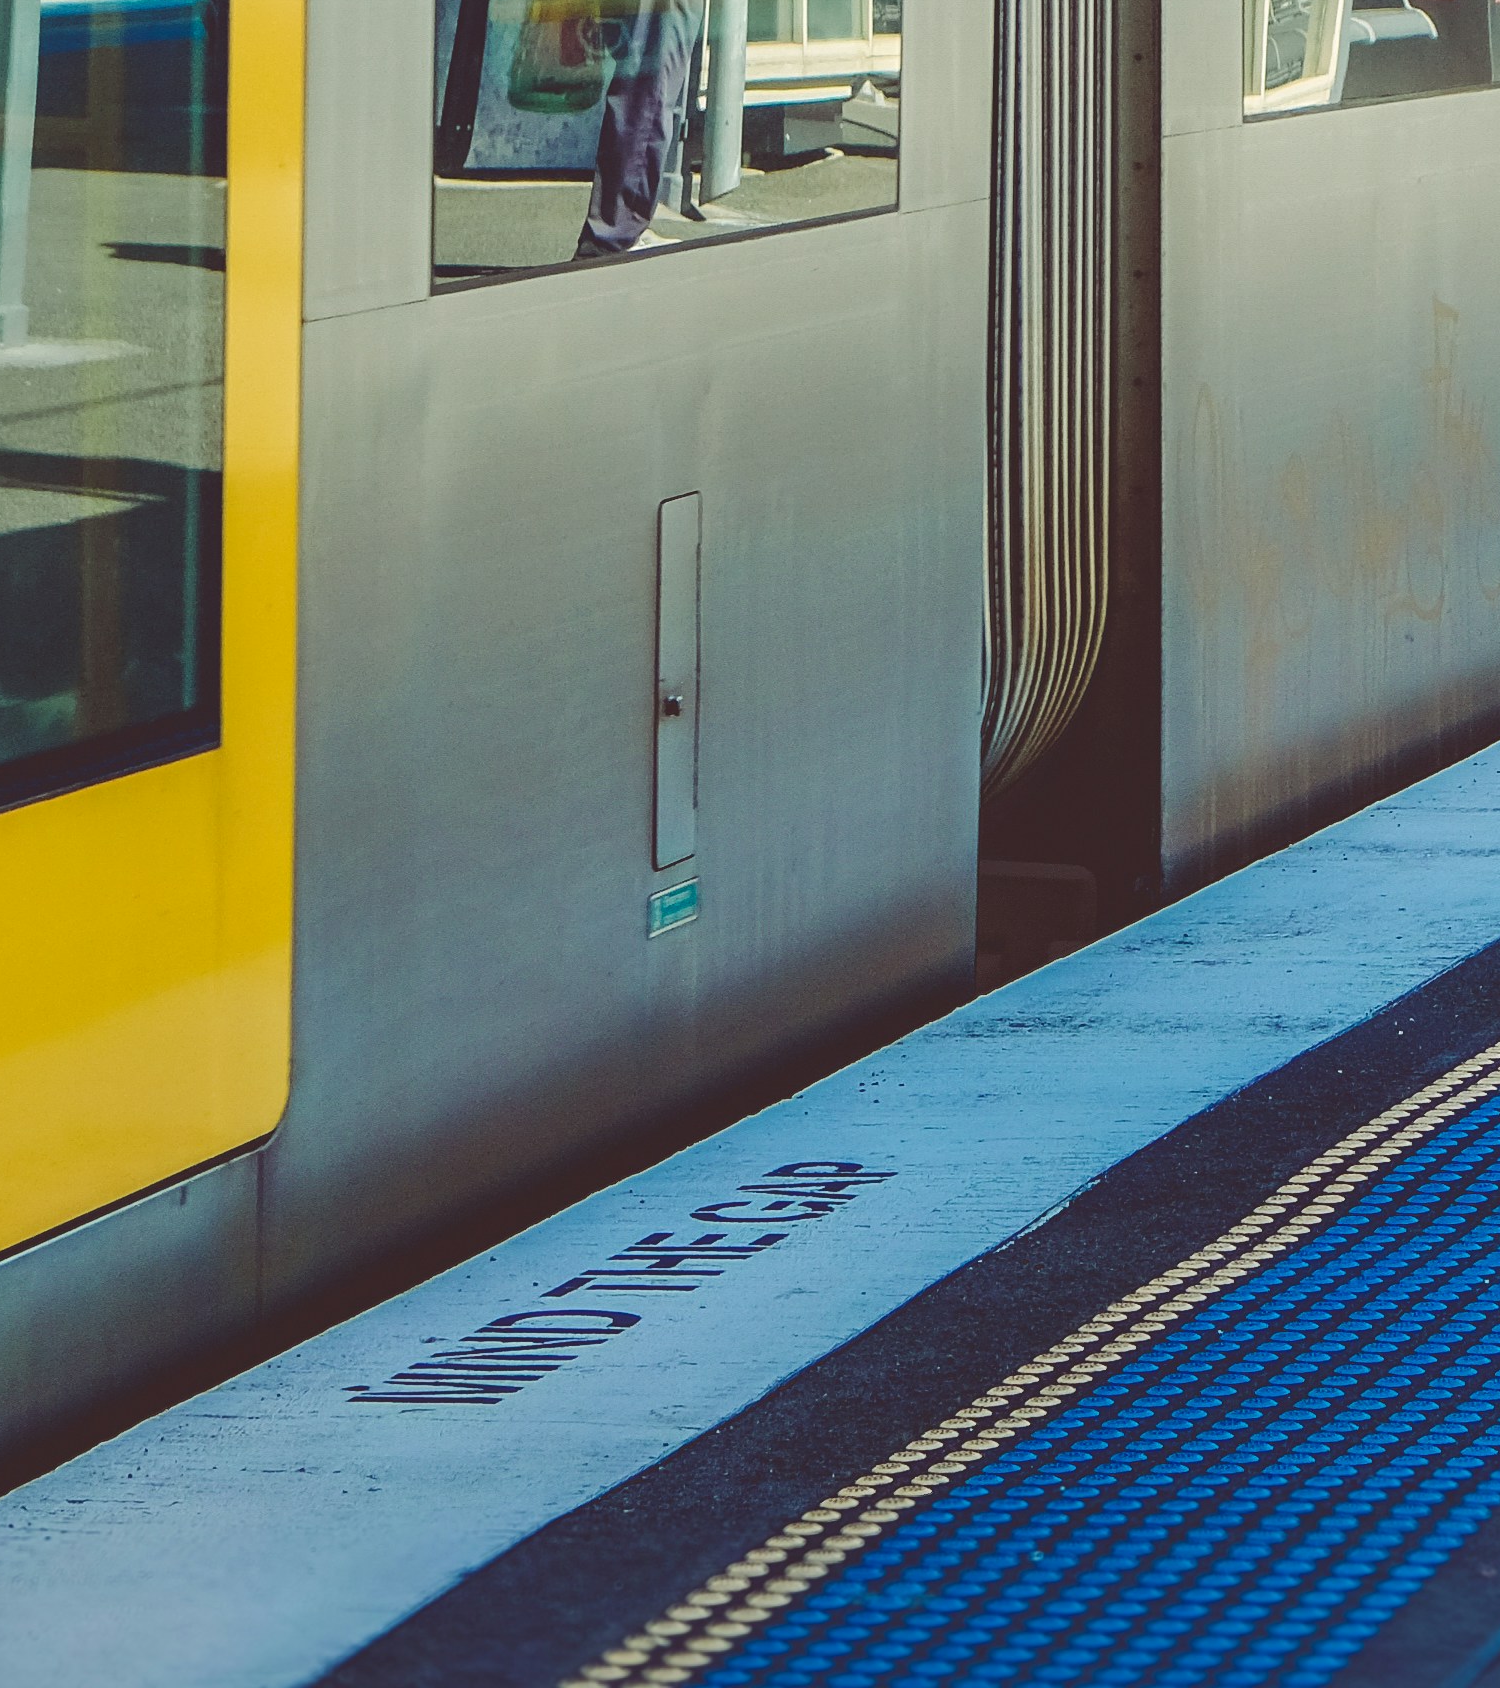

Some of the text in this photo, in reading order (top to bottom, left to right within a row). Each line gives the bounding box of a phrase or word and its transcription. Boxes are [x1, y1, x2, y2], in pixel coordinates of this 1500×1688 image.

[342, 1161, 899, 1405] MIND THE GAP
